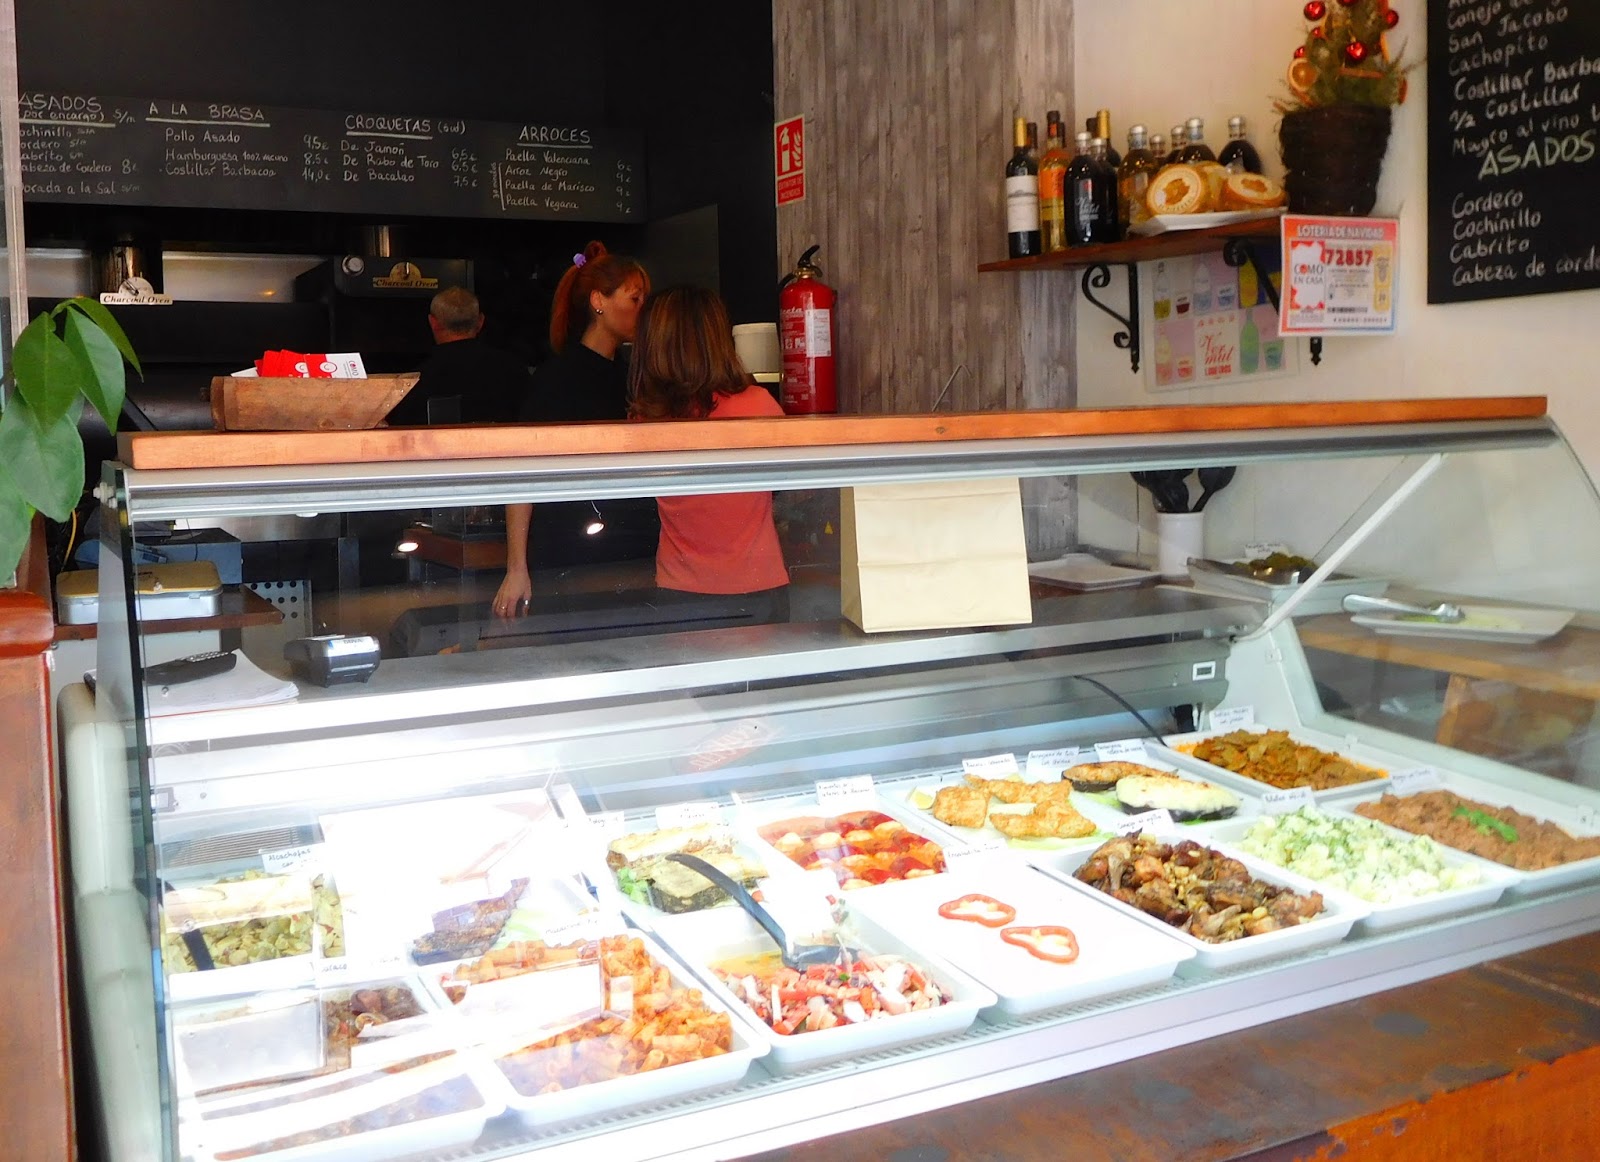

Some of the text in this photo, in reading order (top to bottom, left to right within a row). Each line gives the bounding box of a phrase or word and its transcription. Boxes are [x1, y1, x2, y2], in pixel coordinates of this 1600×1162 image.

[1449, 6, 1568, 53] San Jacobo
[1454, 66, 1534, 101] Costillar
[18, 93, 101, 113] ASADOS
[1485, 82, 1581, 120] Costillar
[149, 102, 265, 121] A LA BRASA
[19, 126, 72, 138] ochinillo
[345, 115, 431, 132] CROQUETAS
[165, 127, 241, 144] Pollo Asado
[519, 125, 590, 144] ARROCES
[1452, 113, 1580, 158] Magro al vino
[20, 139, 61, 150] ordero
[340, 140, 359, 151] De
[20, 151, 63, 162] abrito
[165, 148, 239, 165] Hamburguesa
[343, 155, 440, 169] De Rabo de Toro
[505, 148, 590, 165] Paella Valenciana
[1478, 128, 1597, 181] ASADOS
[21, 163, 57, 173] abeza
[59, 162, 71, 173] de
[165, 162, 277, 177] Costillar Barbacoa
[344, 169, 415, 183] De Bacalao
[505, 165, 568, 181] Arroz Negro
[67, 185, 75, 195] a
[81, 181, 91, 194] la
[97, 181, 117, 194] Sal
[505, 180, 595, 192] Paella de Marisco
[506, 195, 579, 211] Paella Vegana
[1452, 189, 1523, 219] Cordero
[1453, 207, 1541, 240] Cochinillo
[1450, 234, 1530, 264] Cabrito
[1294, 264, 1324, 275] COMO
[1452, 263, 1517, 287] Cabeza
[1525, 252, 1545, 278] de
[103, 295, 170, 304] Charcoal Oven
